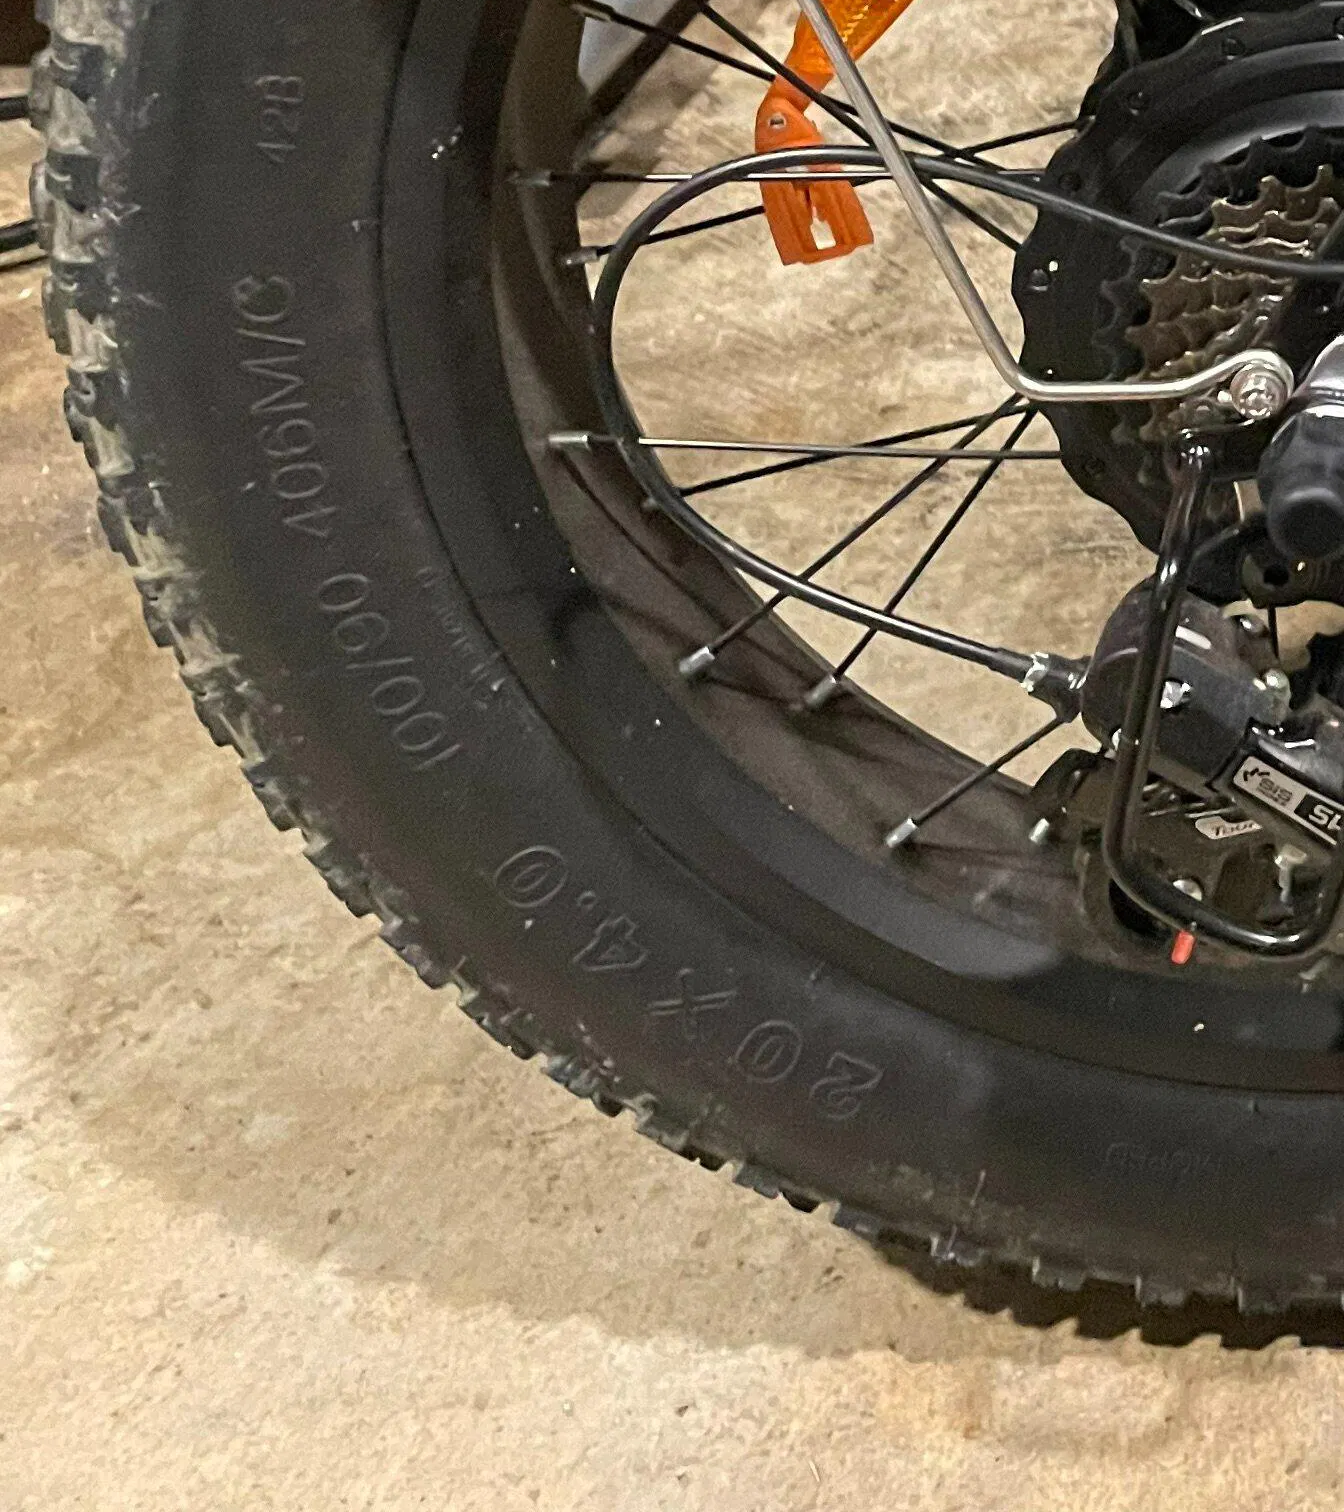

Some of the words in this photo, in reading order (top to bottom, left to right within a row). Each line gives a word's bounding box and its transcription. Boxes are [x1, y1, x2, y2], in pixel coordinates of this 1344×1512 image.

[317, 572, 463, 772] 100/90
[493, 844, 650, 973] 4.0
[733, 1018, 886, 1122] 20
